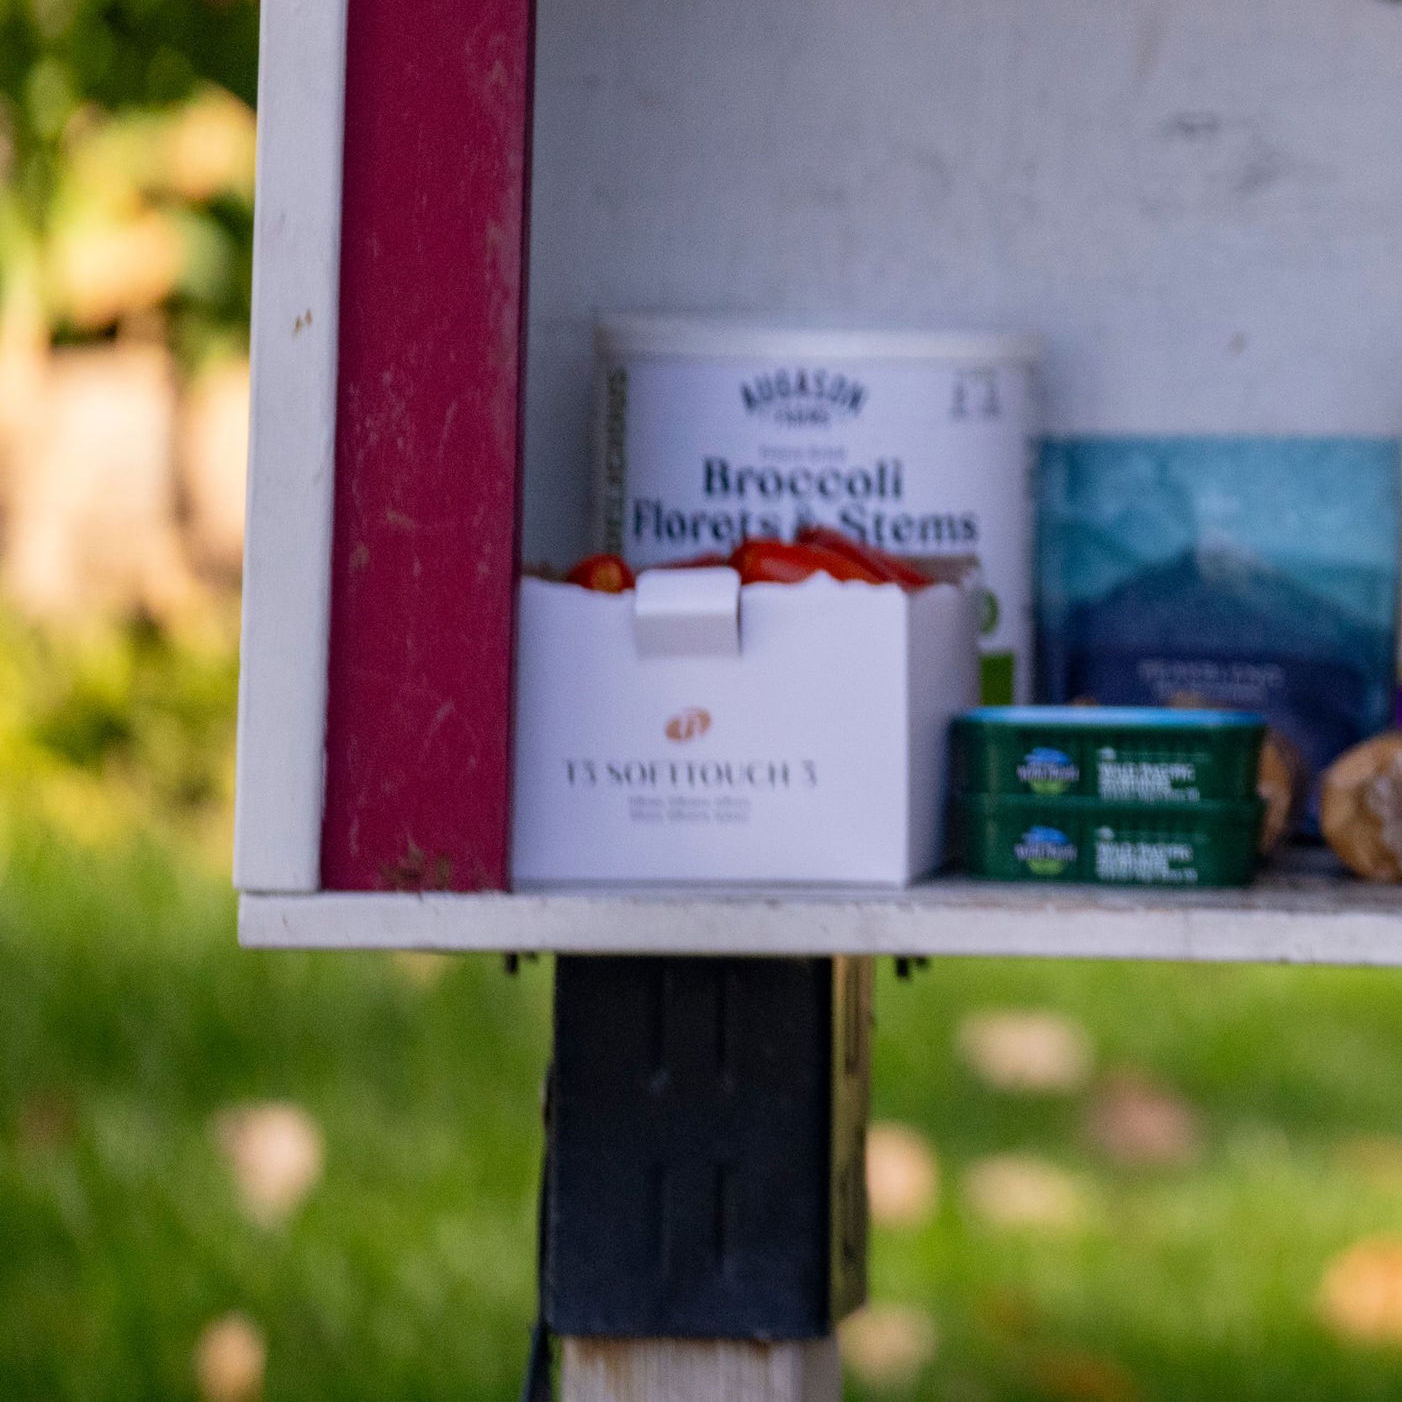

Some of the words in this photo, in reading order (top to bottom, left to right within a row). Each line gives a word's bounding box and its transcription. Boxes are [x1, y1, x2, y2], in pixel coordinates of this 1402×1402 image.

[740, 365, 867, 417] AUGASON
[703, 455, 903, 499] Broccoli
[633, 498, 782, 546] Florets
[838, 502, 979, 547] Stems
